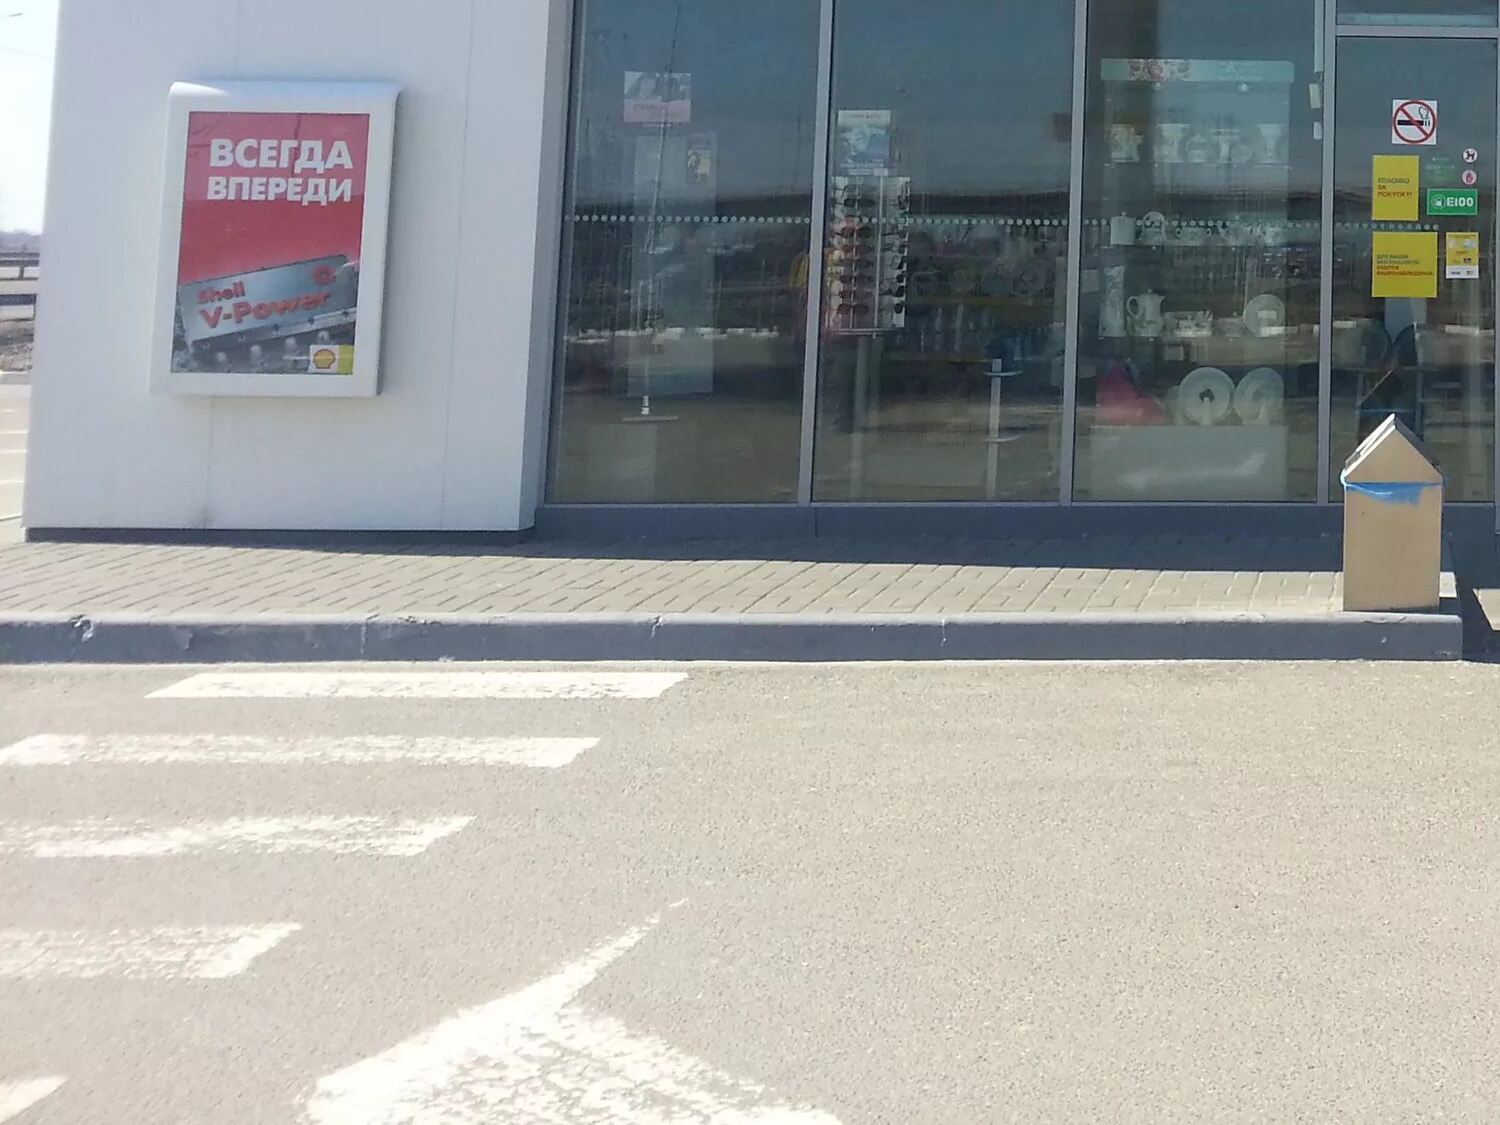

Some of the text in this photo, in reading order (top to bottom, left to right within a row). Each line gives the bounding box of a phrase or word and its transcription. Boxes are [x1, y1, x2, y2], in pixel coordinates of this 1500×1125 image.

[209, 138, 353, 174] ВСЕГДА
[207, 176, 352, 206] ВПЕРЕДИ
[1446, 196, 1474, 207] E100
[197, 281, 246, 305] Shell
[199, 291, 331, 329] V-Power
